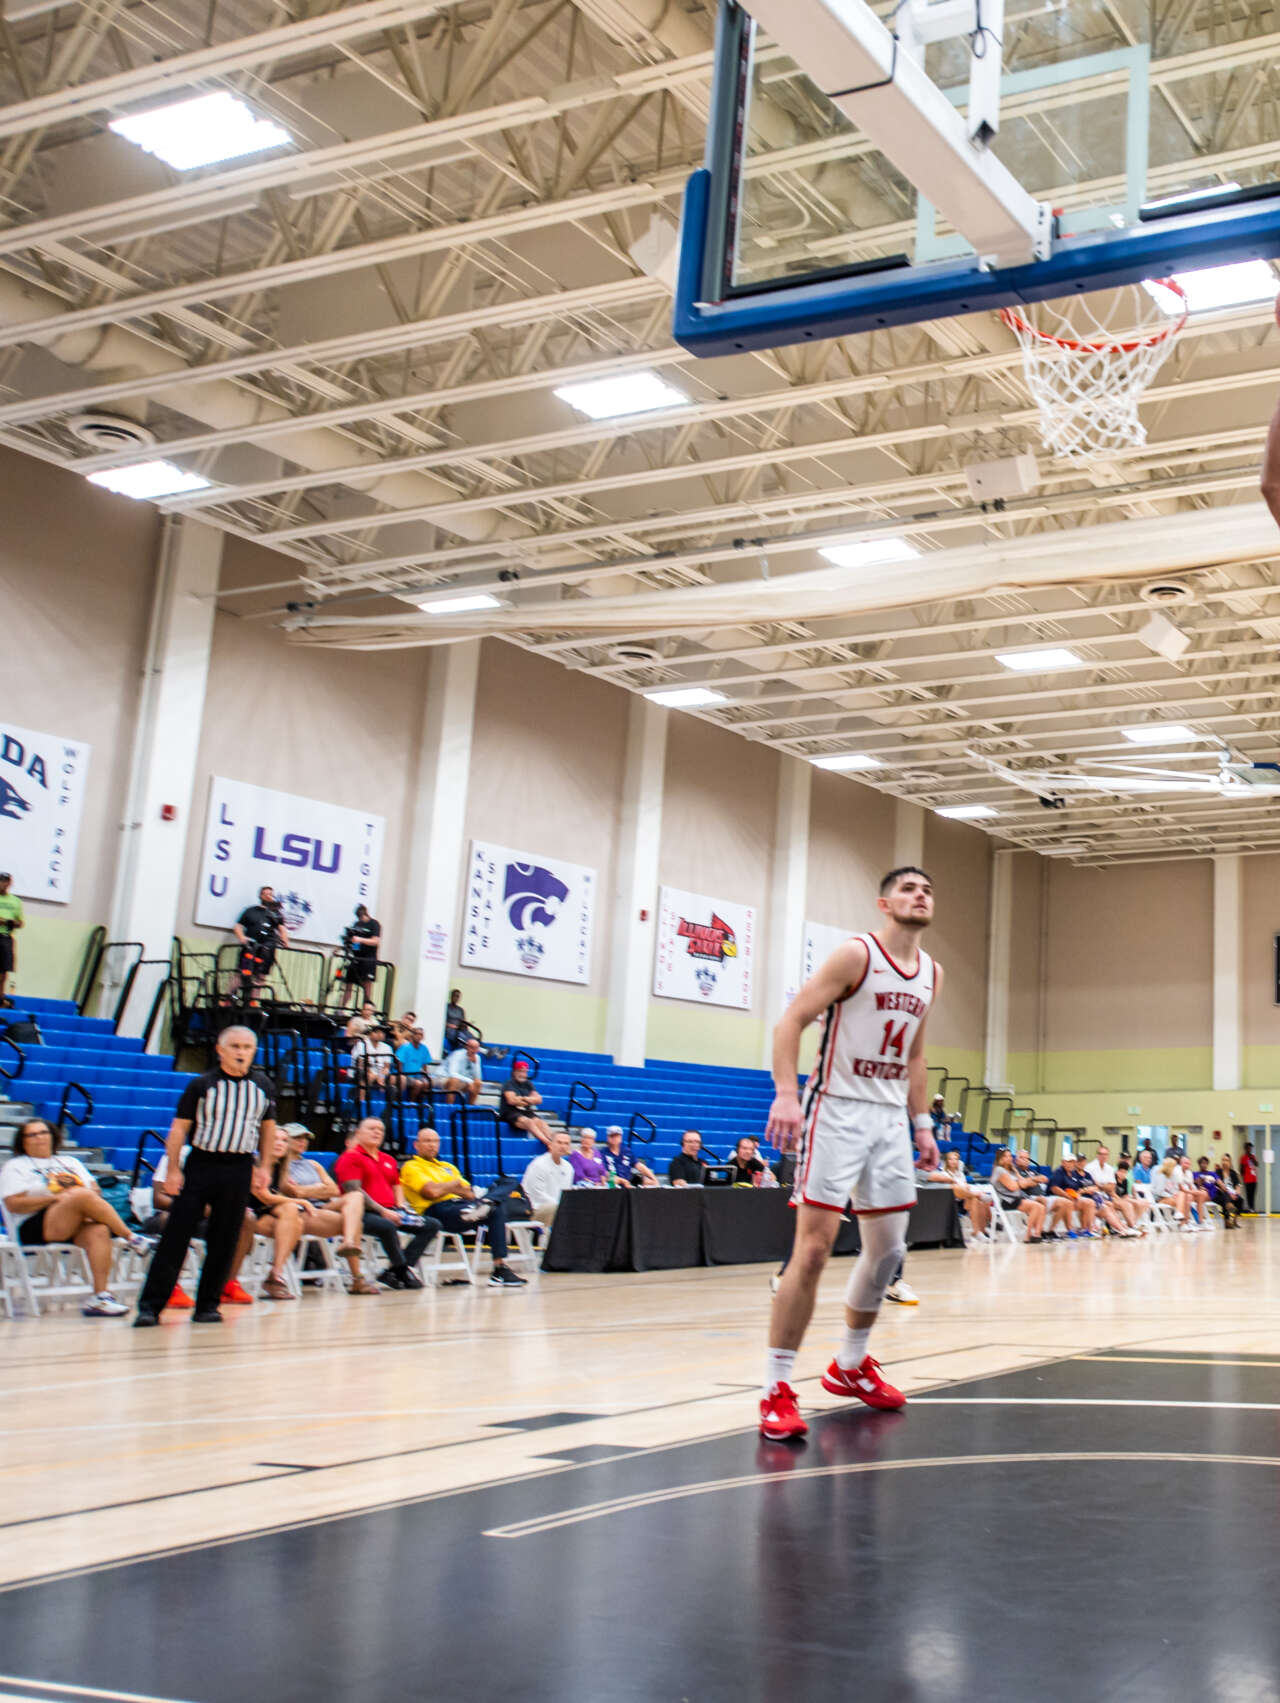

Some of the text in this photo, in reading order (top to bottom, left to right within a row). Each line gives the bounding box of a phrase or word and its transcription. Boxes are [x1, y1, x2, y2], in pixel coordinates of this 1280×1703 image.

[209, 802, 235, 898] LSU
[252, 825, 342, 875] LSU
[874, 992, 926, 1018] WESTERN
[879, 1019, 909, 1058] 14
[853, 1057, 910, 1081] KENTUCK
